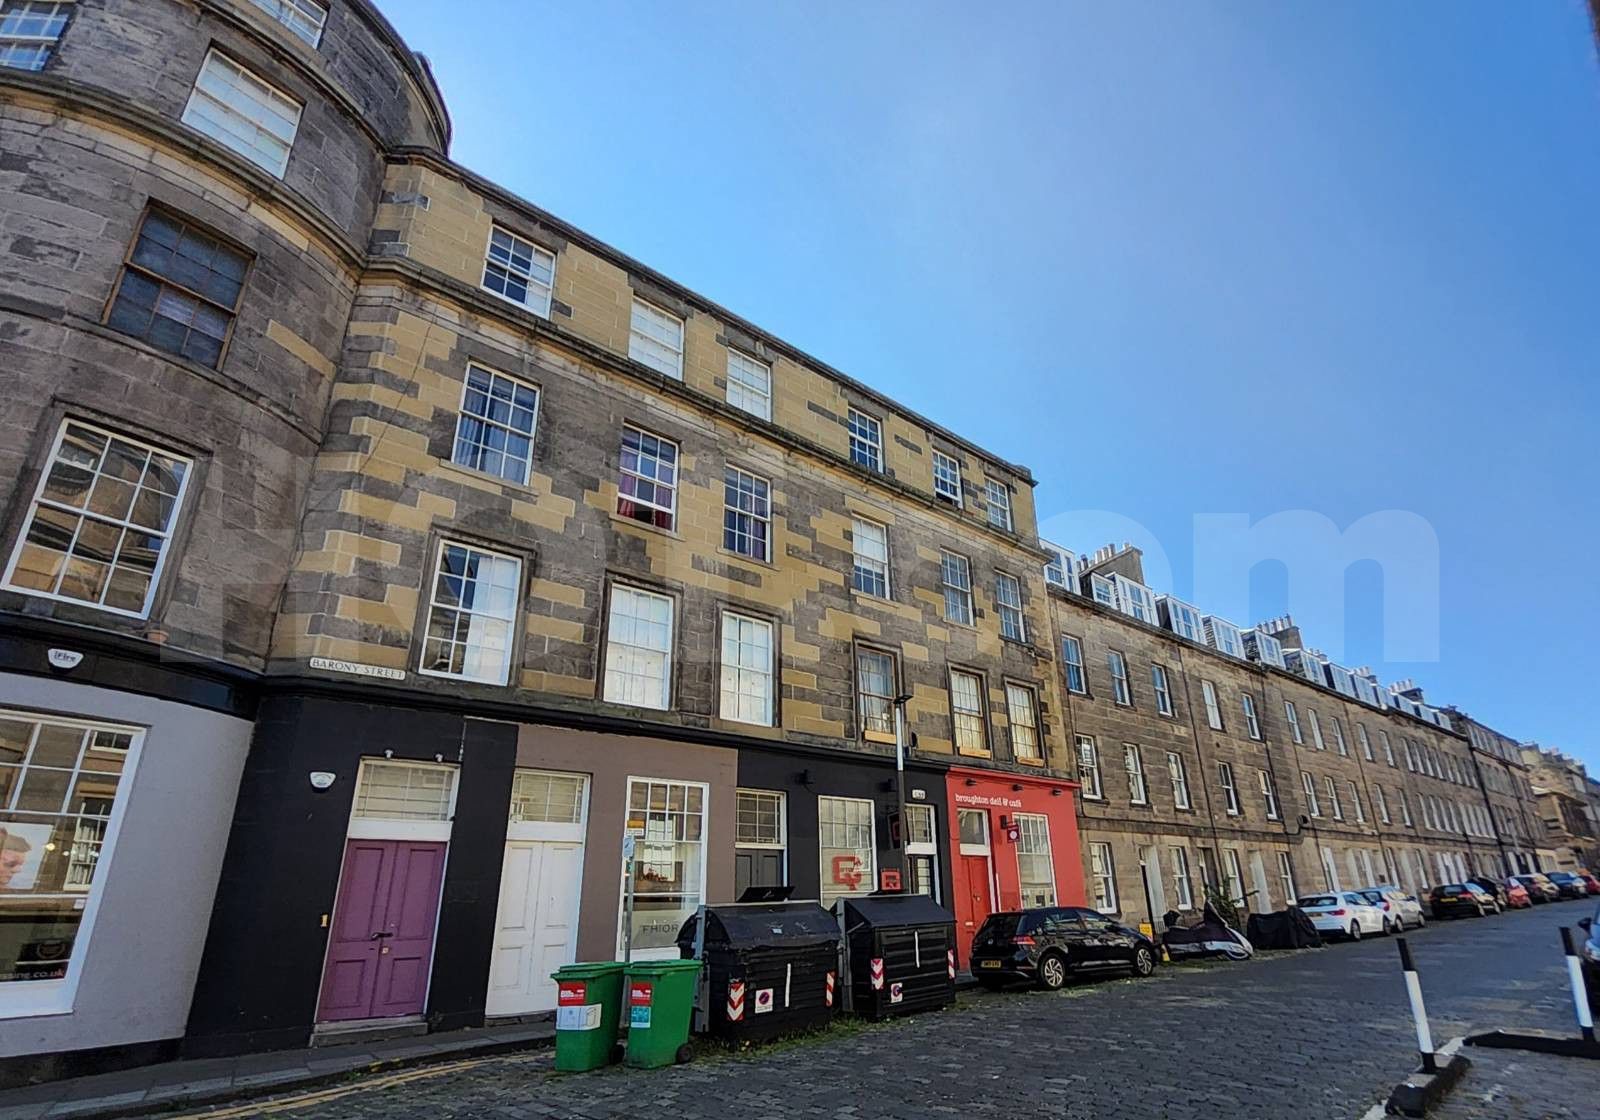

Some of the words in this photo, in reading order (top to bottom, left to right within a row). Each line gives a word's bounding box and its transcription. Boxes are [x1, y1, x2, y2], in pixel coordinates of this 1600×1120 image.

[312, 658, 358, 672] BARONY
[364, 667, 402, 678] STREET
[955, 794, 988, 805] broughton
